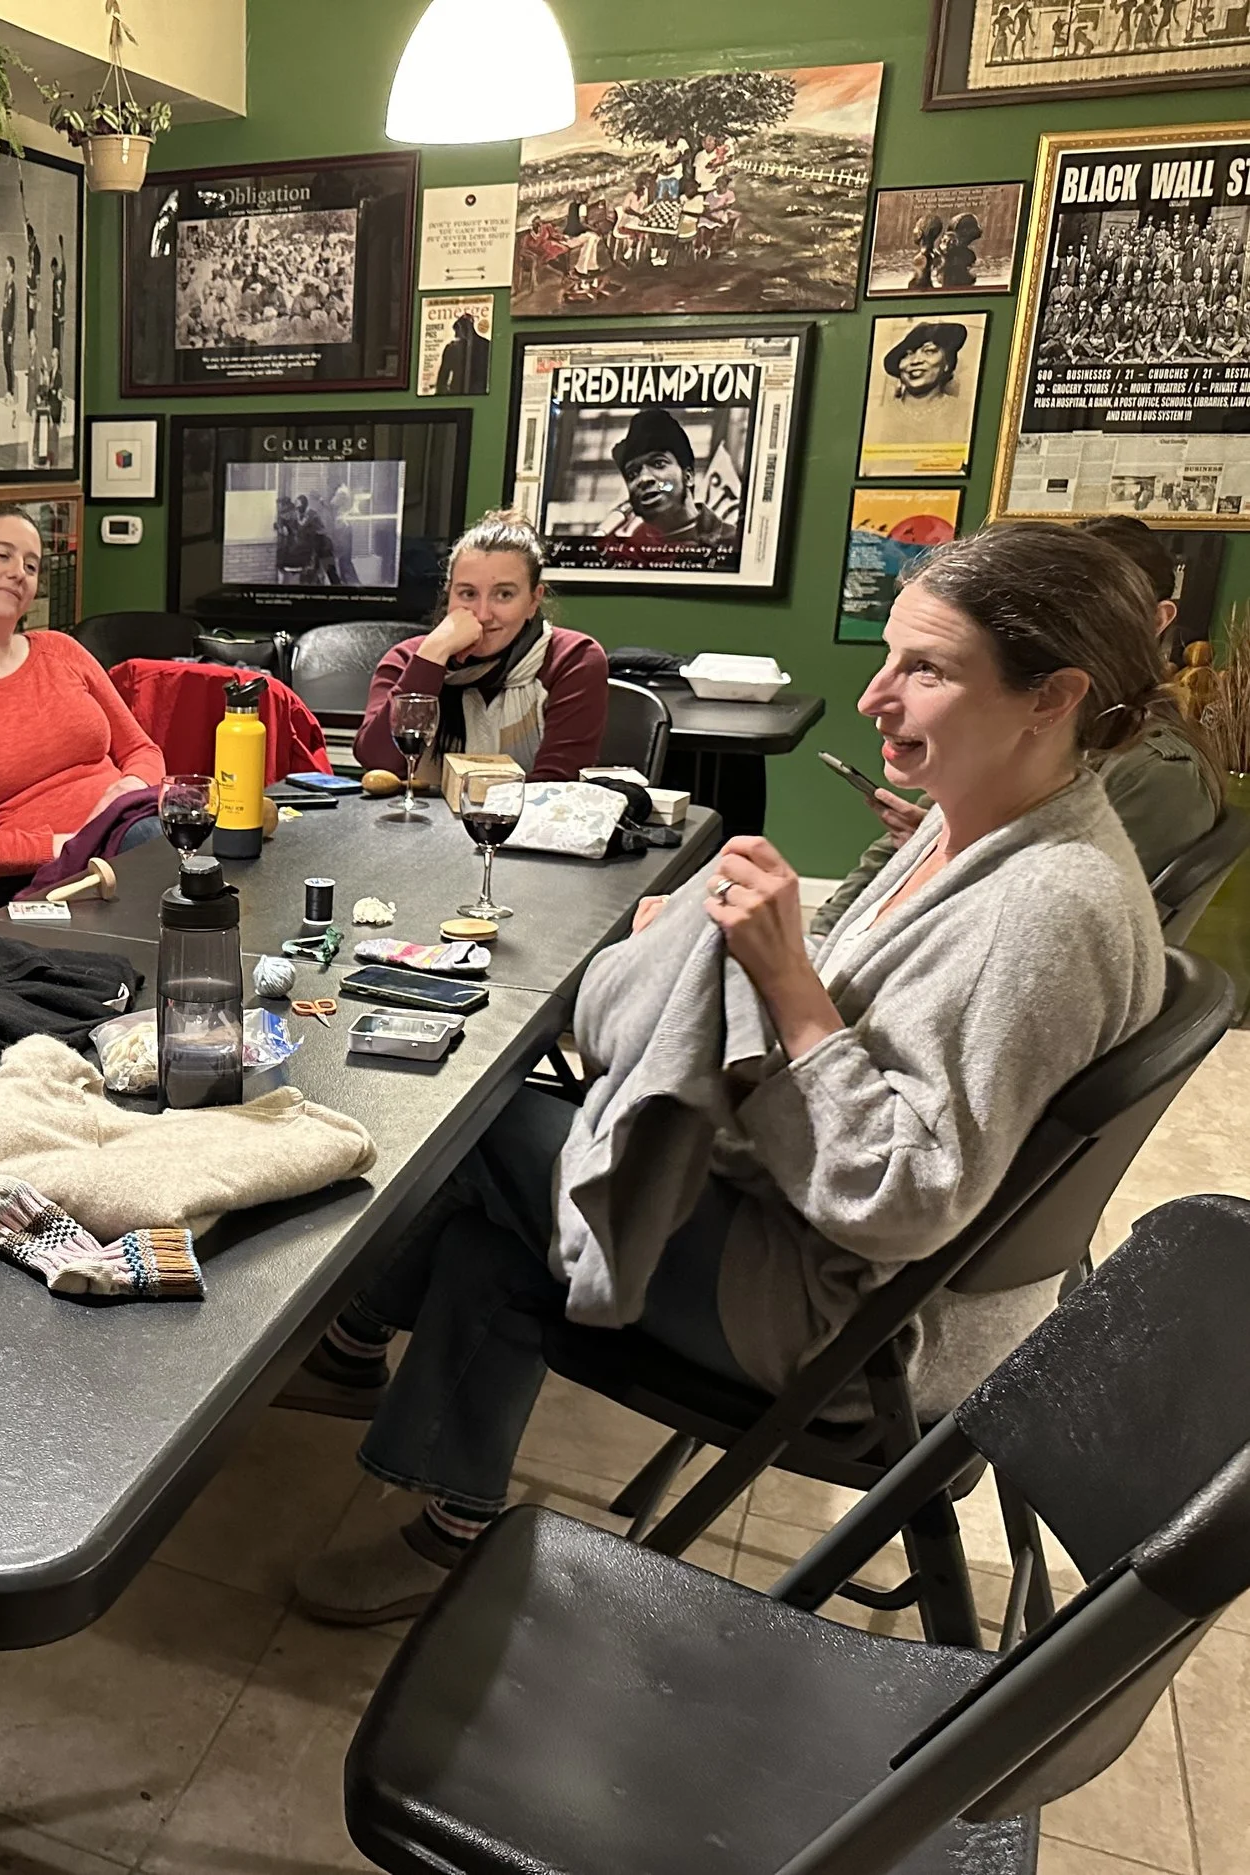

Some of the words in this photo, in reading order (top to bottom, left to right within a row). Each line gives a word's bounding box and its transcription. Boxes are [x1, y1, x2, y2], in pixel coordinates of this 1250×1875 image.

[1061, 164, 1142, 204] BLACK
[1150, 160, 1214, 200] WALL
[223, 184, 310, 208] Obligation
[428, 306, 489, 321] emerge
[1038, 370, 1052, 380] 600
[1066, 369, 1112, 380] BUSINESSES
[1125, 369, 1134, 380] 21
[1148, 368, 1189, 379] CHURCHES
[1202, 368, 1212, 378] 21
[1225, 368, 1250, 378] RESTA
[558, 367, 619, 403] FRED
[621, 364, 754, 403] HAMPTON
[1035, 384, 1046, 394] 30
[1052, 383, 1082, 394] GROCERY
[1084, 383, 1110, 394] STORES
[1117, 383, 1123, 394] 2
[1130, 382, 1152, 394] MOVIE
[1154, 382, 1186, 394] THEATRES
[1194, 382, 1200, 394] 6
[1210, 382, 1238, 393] PRIVATE
[1034, 398, 1050, 408] PLUS
[1050, 398, 1056, 408] A
[1088, 398, 1093, 408] A
[1114, 398, 1118, 408] A
[1119, 397, 1137, 408] POST
[1161, 396, 1192, 408] SCHOOLS,
[1194, 396, 1229, 408] LIBRARIES,
[1230, 396, 1246, 407] LAW
[1106, 410, 1120, 421] AND
[1120, 410, 1137, 421] EVEN
[1137, 410, 1142, 420] A
[1143, 410, 1156, 420] BUS
[1158, 410, 1184, 420] SYSTEM
[263, 434, 368, 455] Courage
